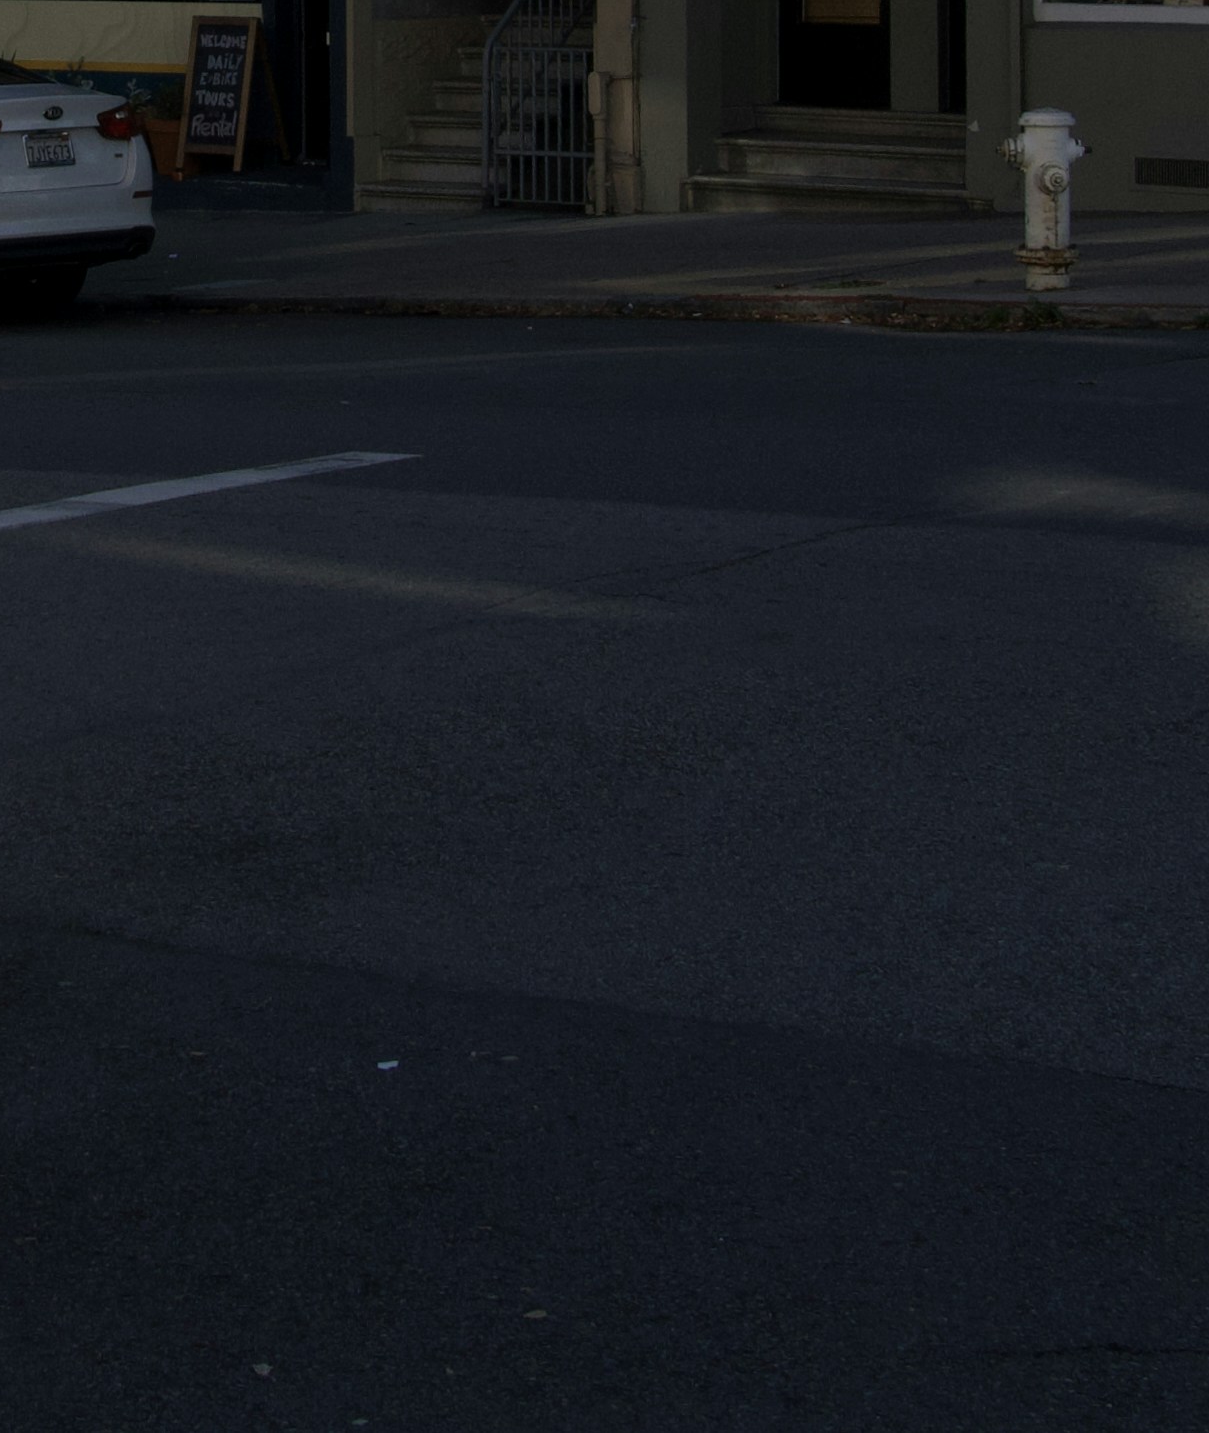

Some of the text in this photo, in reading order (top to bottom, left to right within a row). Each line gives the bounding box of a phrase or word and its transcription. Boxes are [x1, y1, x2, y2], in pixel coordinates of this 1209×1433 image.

[200, 34, 248, 49] WELCOME
[195, 89, 235, 108] TOURS
[28, 144, 72, 164] 7JYE673
